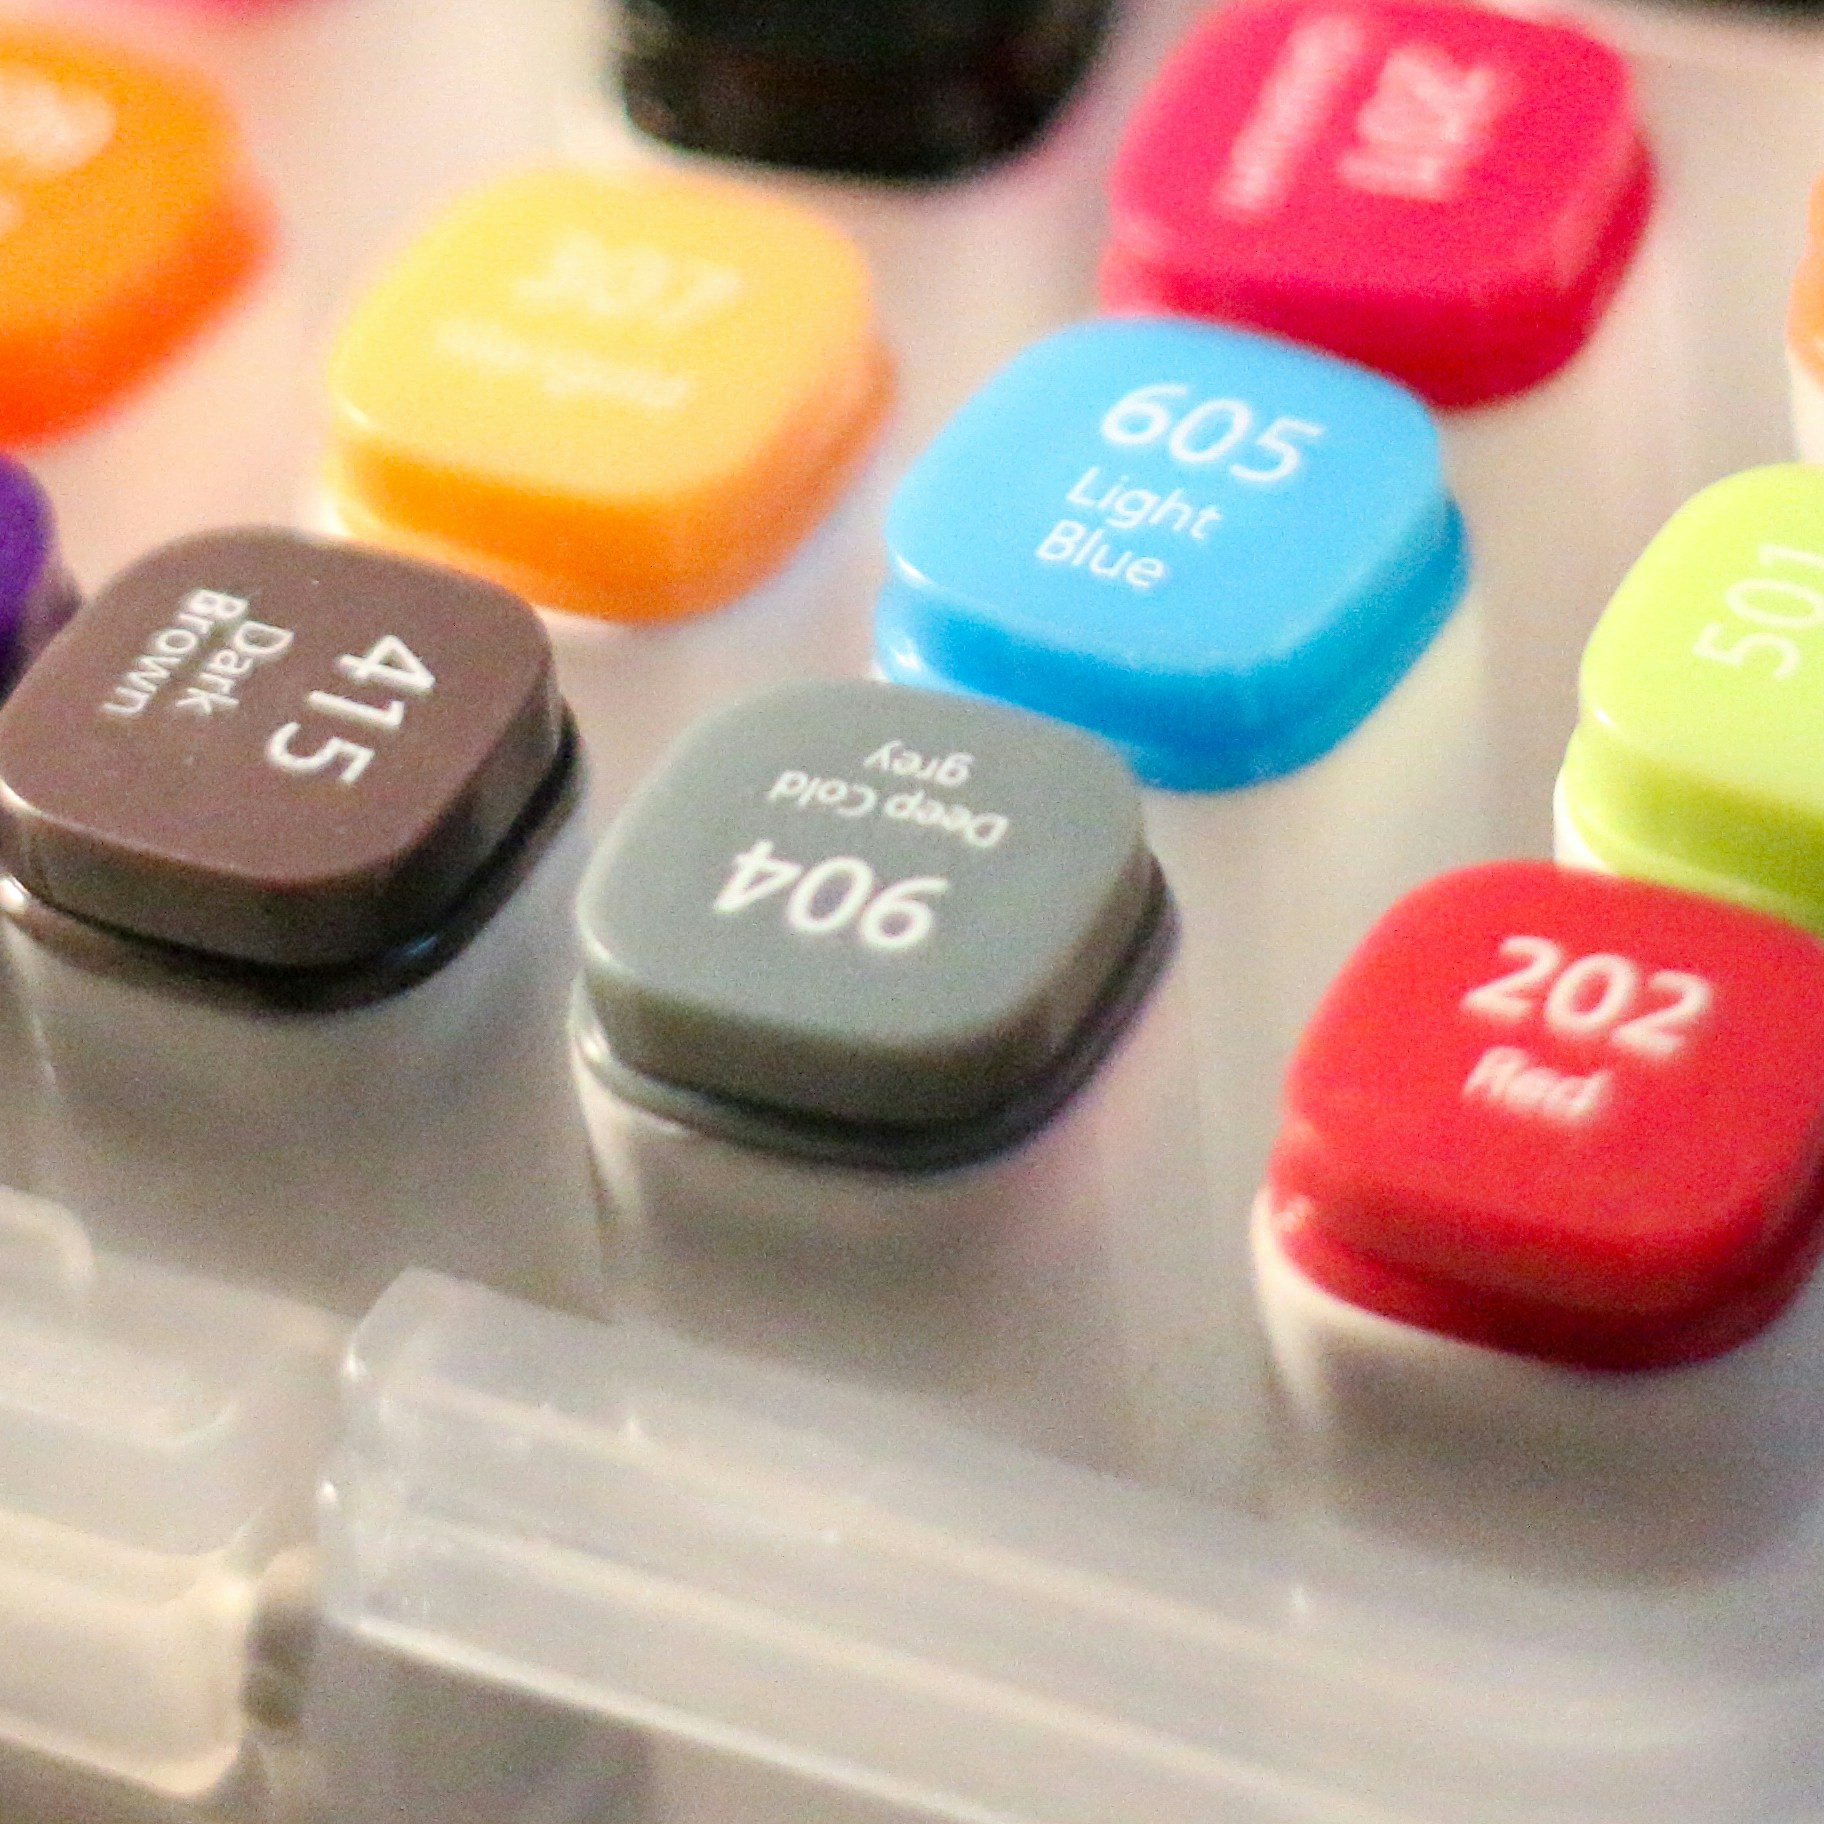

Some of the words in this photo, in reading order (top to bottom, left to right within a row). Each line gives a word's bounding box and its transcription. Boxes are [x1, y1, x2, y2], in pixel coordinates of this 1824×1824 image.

[1100, 381, 1325, 487] 605
[1064, 464, 1224, 544] Light
[1034, 519, 1166, 593] Blue
[100, 586, 249, 722] Brown
[173, 617, 295, 719] Dark
[264, 631, 435, 790] 415
[768, 766, 882, 822] Cold
[863, 737, 974, 791] grey
[881, 785, 1010, 850] Deep
[712, 839, 950, 957] 904
[1463, 936, 1714, 1055] 202
[1462, 1045, 1608, 1123] Red
